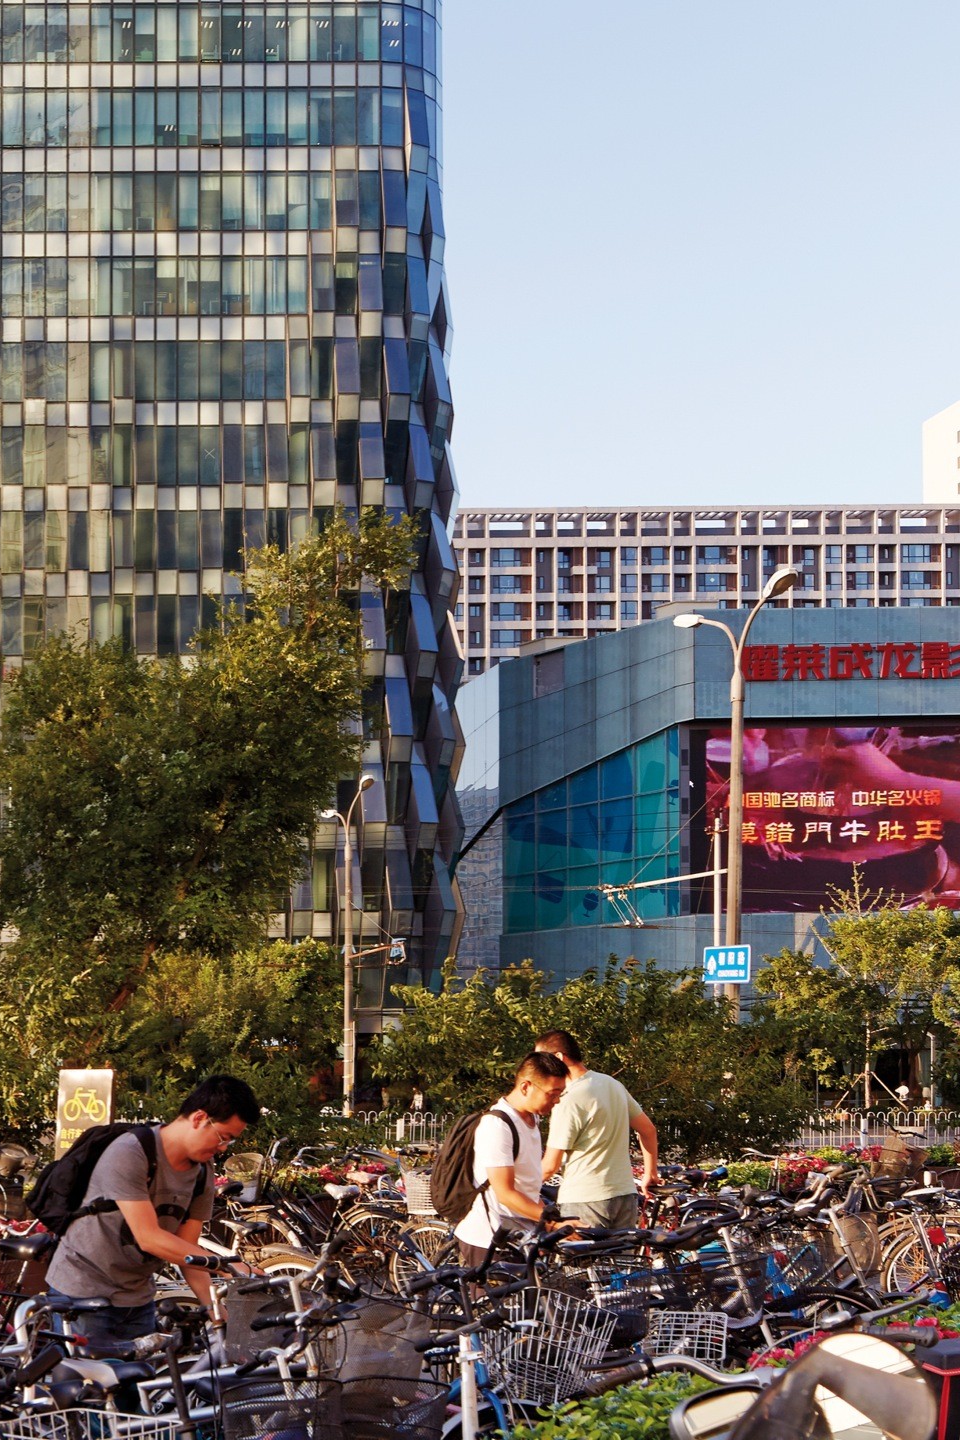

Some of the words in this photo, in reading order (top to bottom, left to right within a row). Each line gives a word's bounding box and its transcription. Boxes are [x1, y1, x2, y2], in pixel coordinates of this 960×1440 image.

[727, 791, 835, 808] 国驰名商标
[851, 790, 942, 807] 中华名火锅
